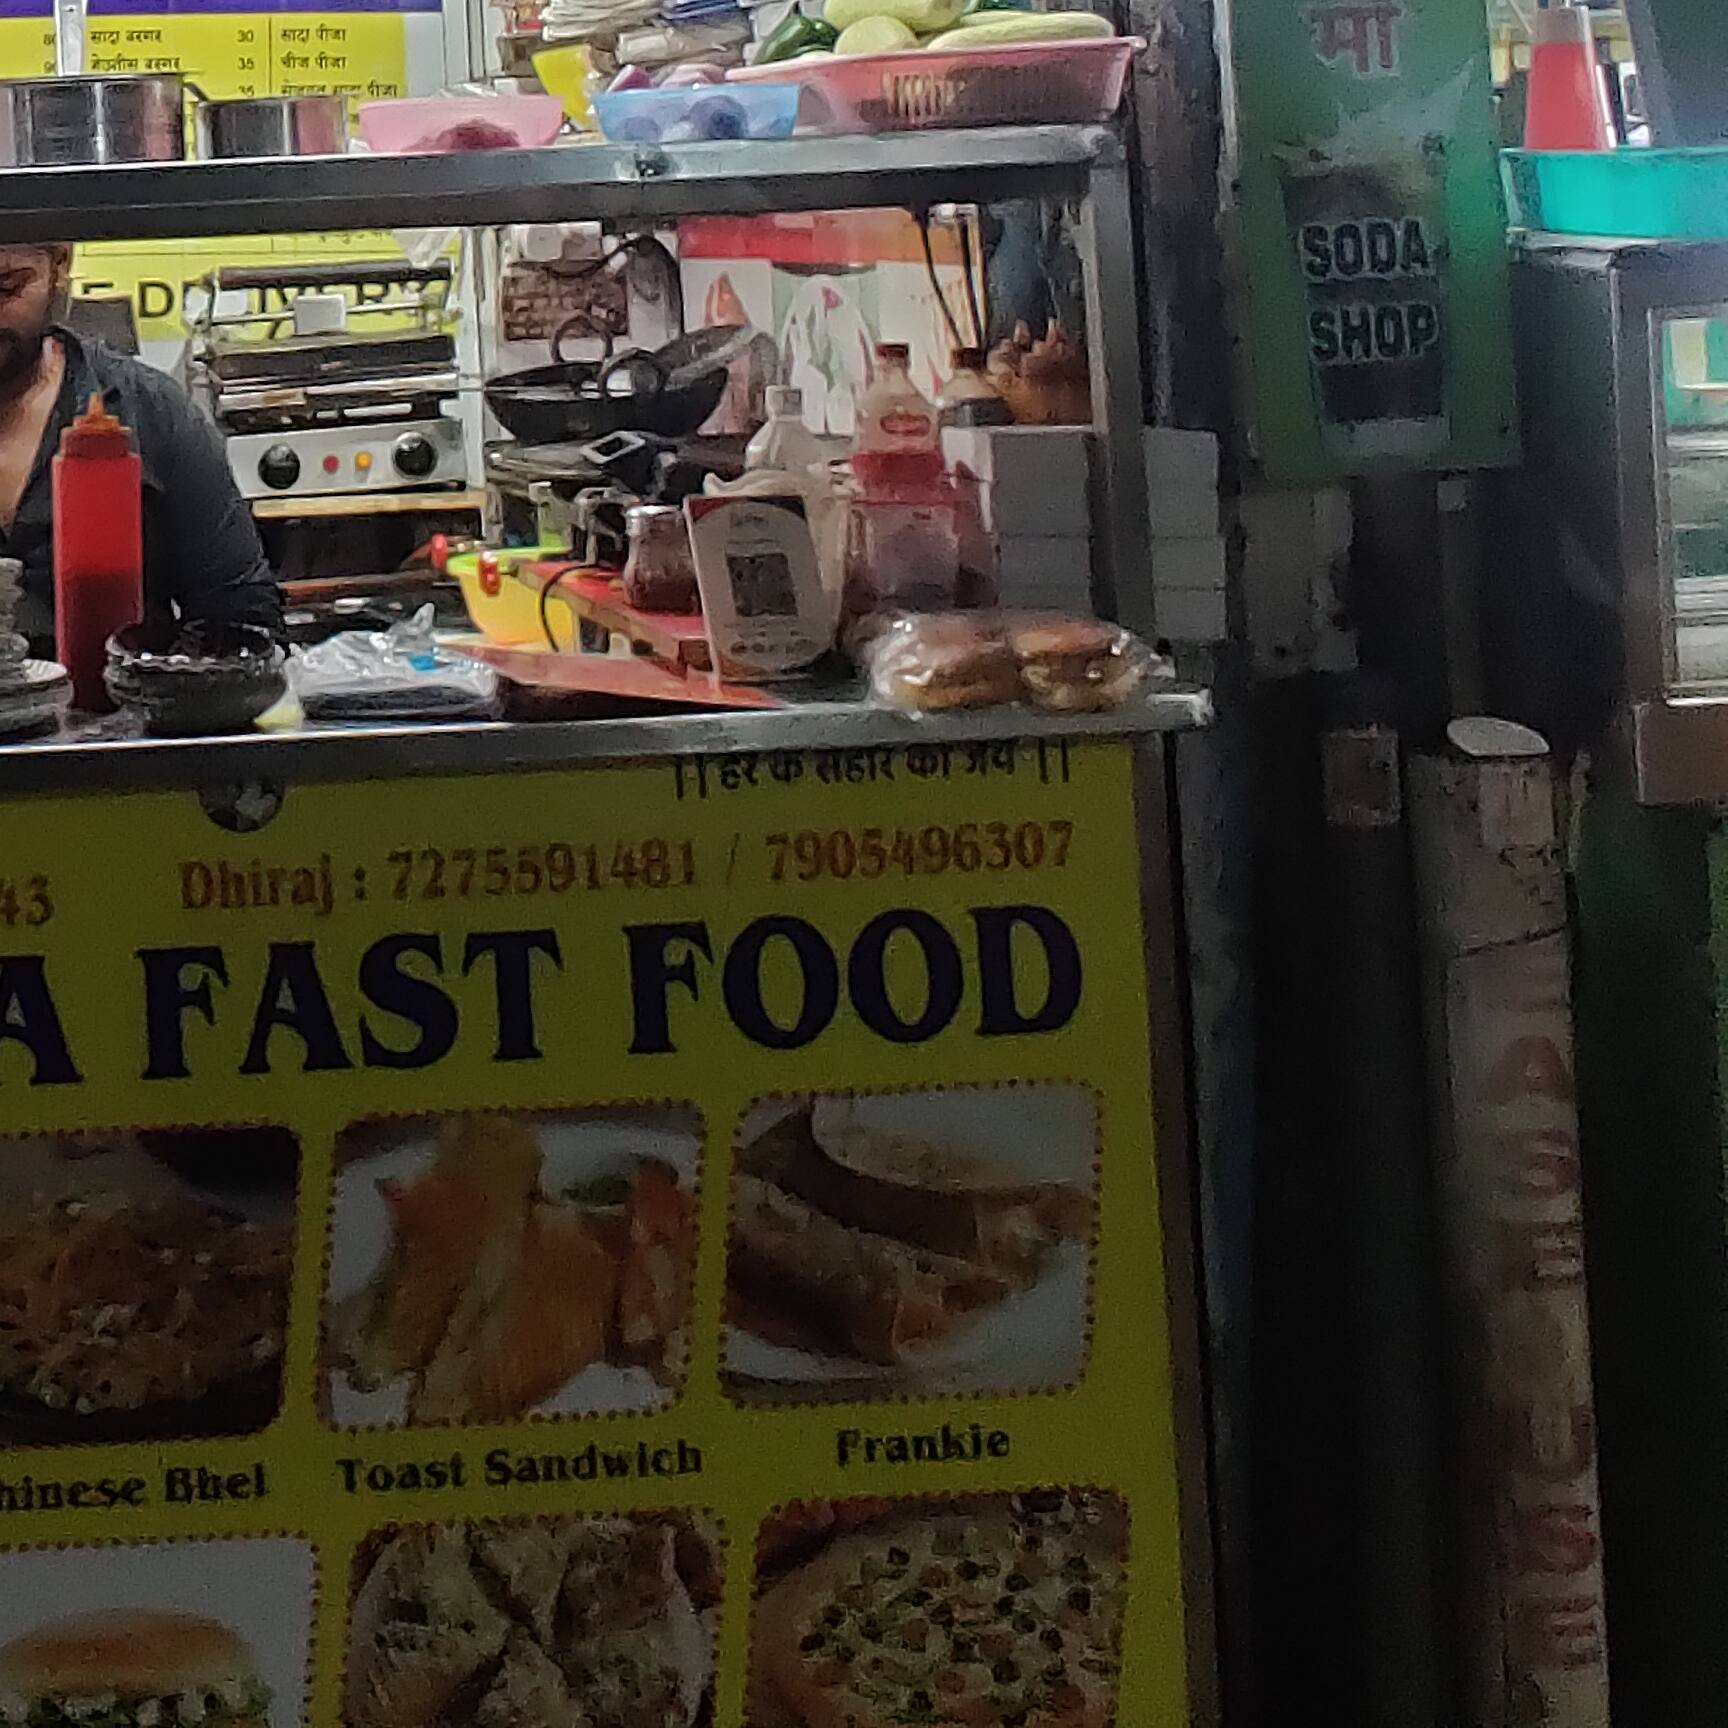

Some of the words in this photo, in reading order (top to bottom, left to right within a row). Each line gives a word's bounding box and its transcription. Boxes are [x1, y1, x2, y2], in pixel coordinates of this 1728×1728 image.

[236, 29, 255, 43] 30
[1300, 217, 1432, 277] SODA
[1308, 301, 1441, 363] SHOP
[179, 851, 335, 916] Dhiraj
[385, 834, 696, 901] 7275591481
[765, 819, 1073, 881] 7905496307
[136, 928, 563, 1078] FAST
[622, 904, 1083, 1054] FOOD
[335, 1454, 470, 1495] Toast
[483, 1438, 704, 1487] Sandwich
[834, 1422, 1011, 1468] Frankie
[163, 1462, 273, 1504] Bhel
